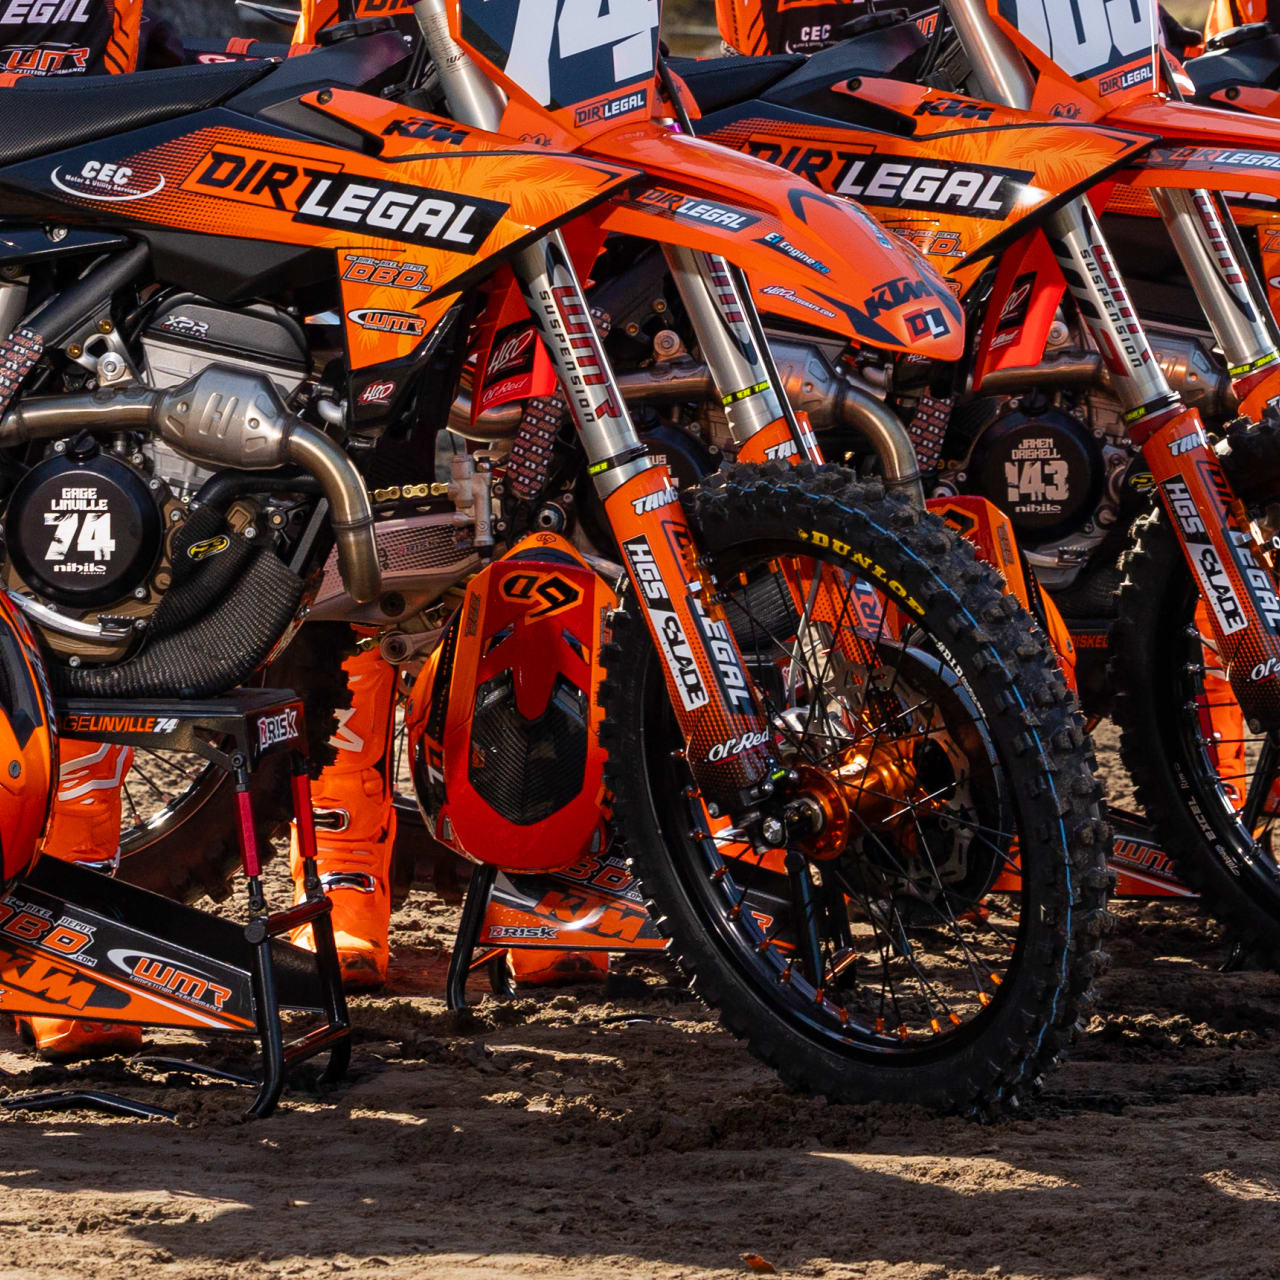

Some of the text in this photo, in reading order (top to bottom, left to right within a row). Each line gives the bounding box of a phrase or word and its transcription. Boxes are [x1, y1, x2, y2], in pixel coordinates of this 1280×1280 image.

[800, 24, 832, 41] CEC
[1100, 65, 1153, 96] DIRT LEGAL
[576, 90, 646, 126] DIRT LEGAL
[914, 99, 994, 121] KTM
[381, 117, 471, 146] KTM
[80, 159, 133, 186] CEC
[1170, 147, 1220, 166] DIRT
[65, 173, 84, 184] Motor
[92, 180, 113, 191] Utility
[743, 140, 1008, 211] DIRT LEGAL
[196, 150, 478, 244] DIRT LEGAL
[643, 188, 749, 230] DIRT LEGAL
[346, 262, 423, 287] DBD
[863, 276, 934, 319] KTM
[1079, 247, 1144, 369] SUSPENSION
[164, 315, 209, 333] XPR
[365, 312, 426, 332] WMR
[906, 310, 945, 340] DL
[487, 328, 535, 375] HBD
[538, 290, 597, 423] SUSPENSION
[61, 487, 98, 499] GAGE
[1004, 460, 1069, 501] 143
[51, 499, 109, 511] LINVILLE
[1014, 503, 1062, 513] nihilo
[1164, 482, 1204, 536] HGS
[43, 512, 116, 561] 74
[53, 562, 107, 573] nihilo
[627, 543, 669, 601] HGS
[810, 529, 926, 617] DUNLOP
[1199, 548, 1246, 631] SLADE
[661, 615, 709, 706] SLADE
[264, 707, 300, 747] RISK
[23, 903, 97, 934] BIKE DEPOT
[74, 953, 97, 967] .COM
[128, 975, 223, 1013] COMPETITION PERFORMANCE
[132, 957, 232, 1007] WMR
